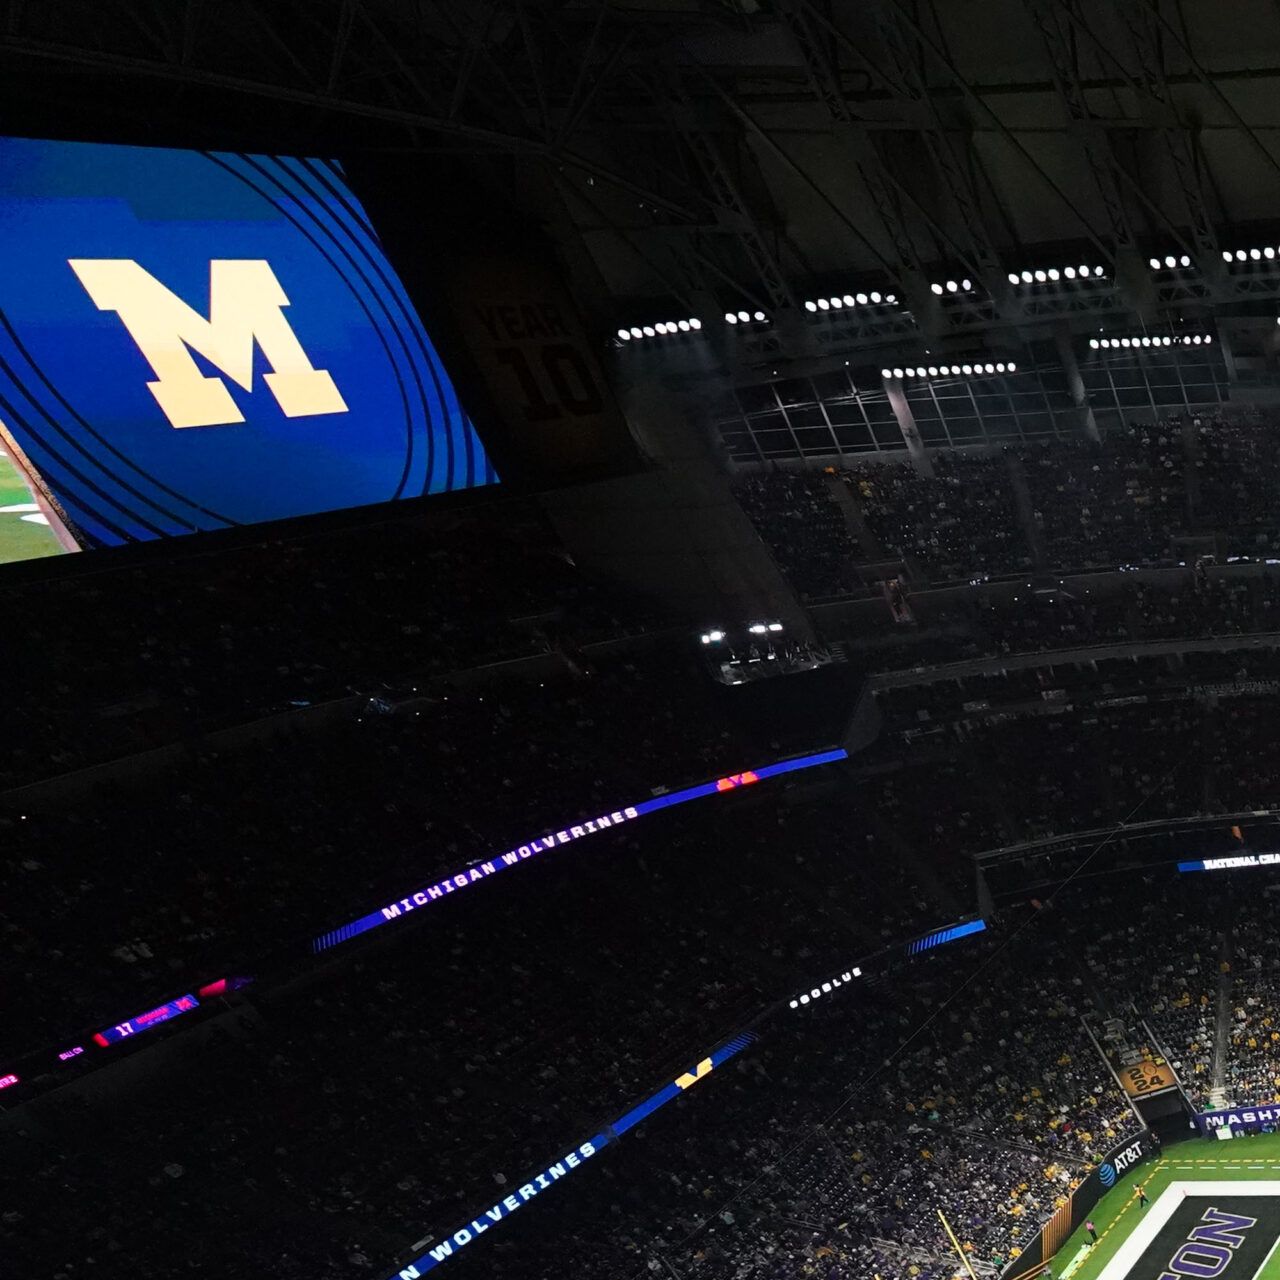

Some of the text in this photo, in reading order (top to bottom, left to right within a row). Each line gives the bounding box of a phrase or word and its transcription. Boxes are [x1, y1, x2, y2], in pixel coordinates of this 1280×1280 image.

[67, 258, 349, 429] M
[496, 344, 603, 421] 10
[381, 806, 639, 921] MICHIGAN WOLVERINES
[1203, 856, 1259, 871] NATIONAL
[115, 1022, 134, 1038] 17
[1113, 1141, 1143, 1174] AT&T
[430, 1141, 597, 1262] WOLVERINES
